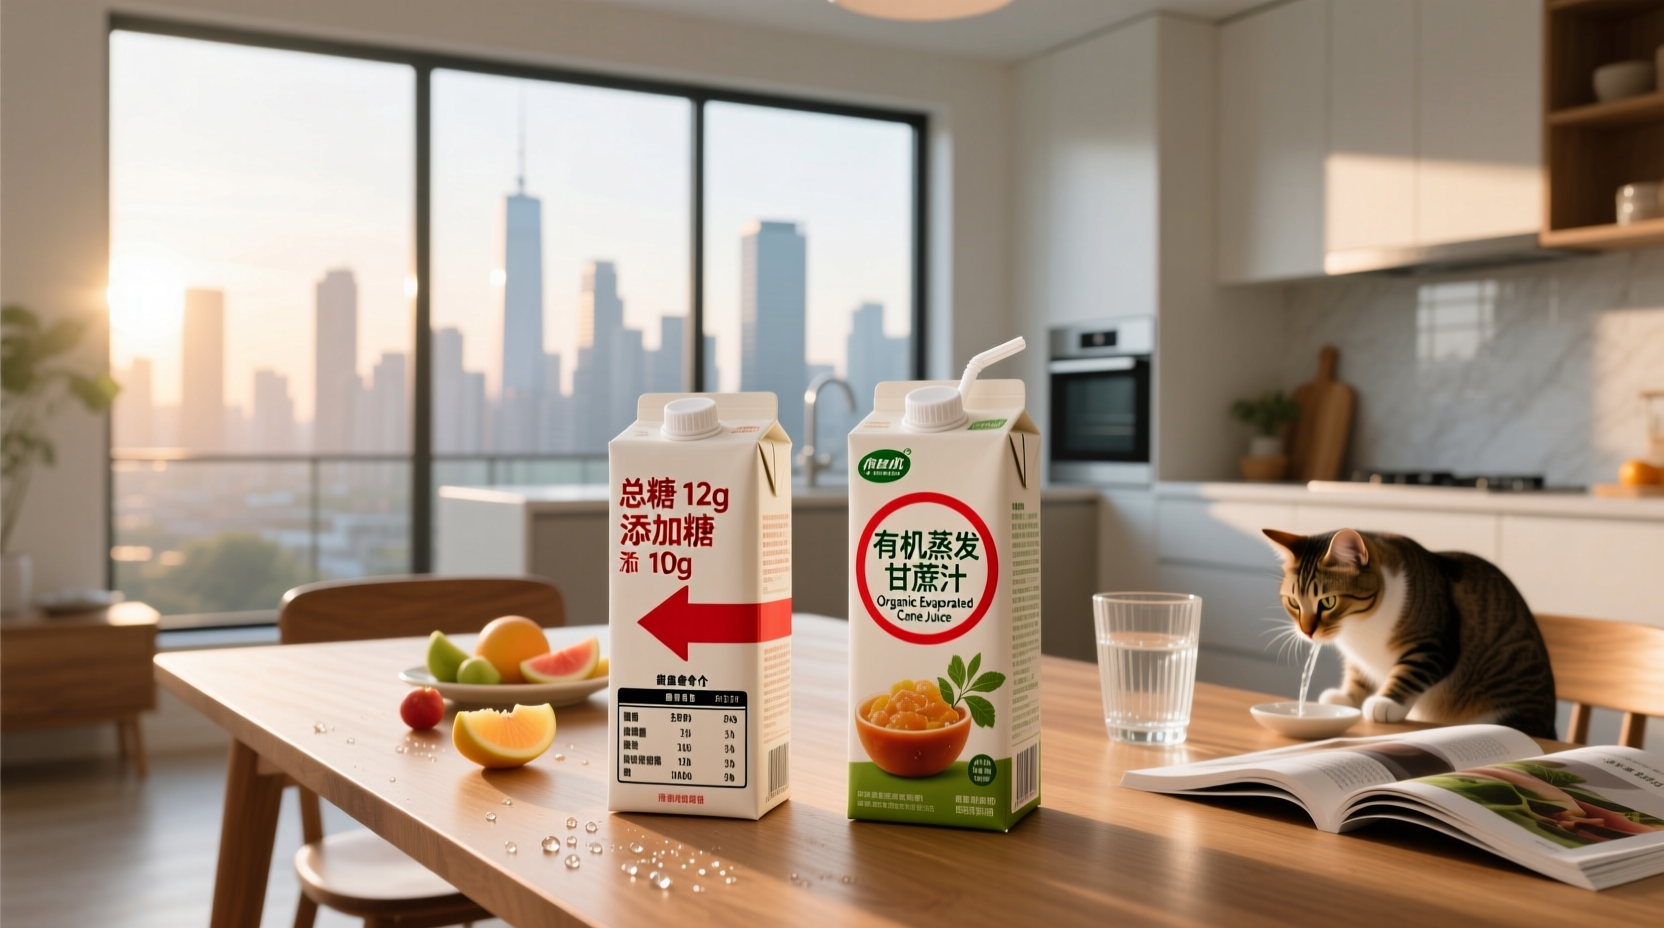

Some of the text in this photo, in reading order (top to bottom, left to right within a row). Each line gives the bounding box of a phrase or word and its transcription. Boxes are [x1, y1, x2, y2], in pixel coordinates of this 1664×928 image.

[619, 477, 729, 513] 总糖 12g
[620, 513, 715, 547] 添加糖
[873, 529, 979, 560] 有机蒸发
[649, 551, 692, 581] 10g
[884, 562, 967, 593] 甘蔗汁
[877, 595, 917, 610] Organic
[925, 611, 952, 623] Juice
